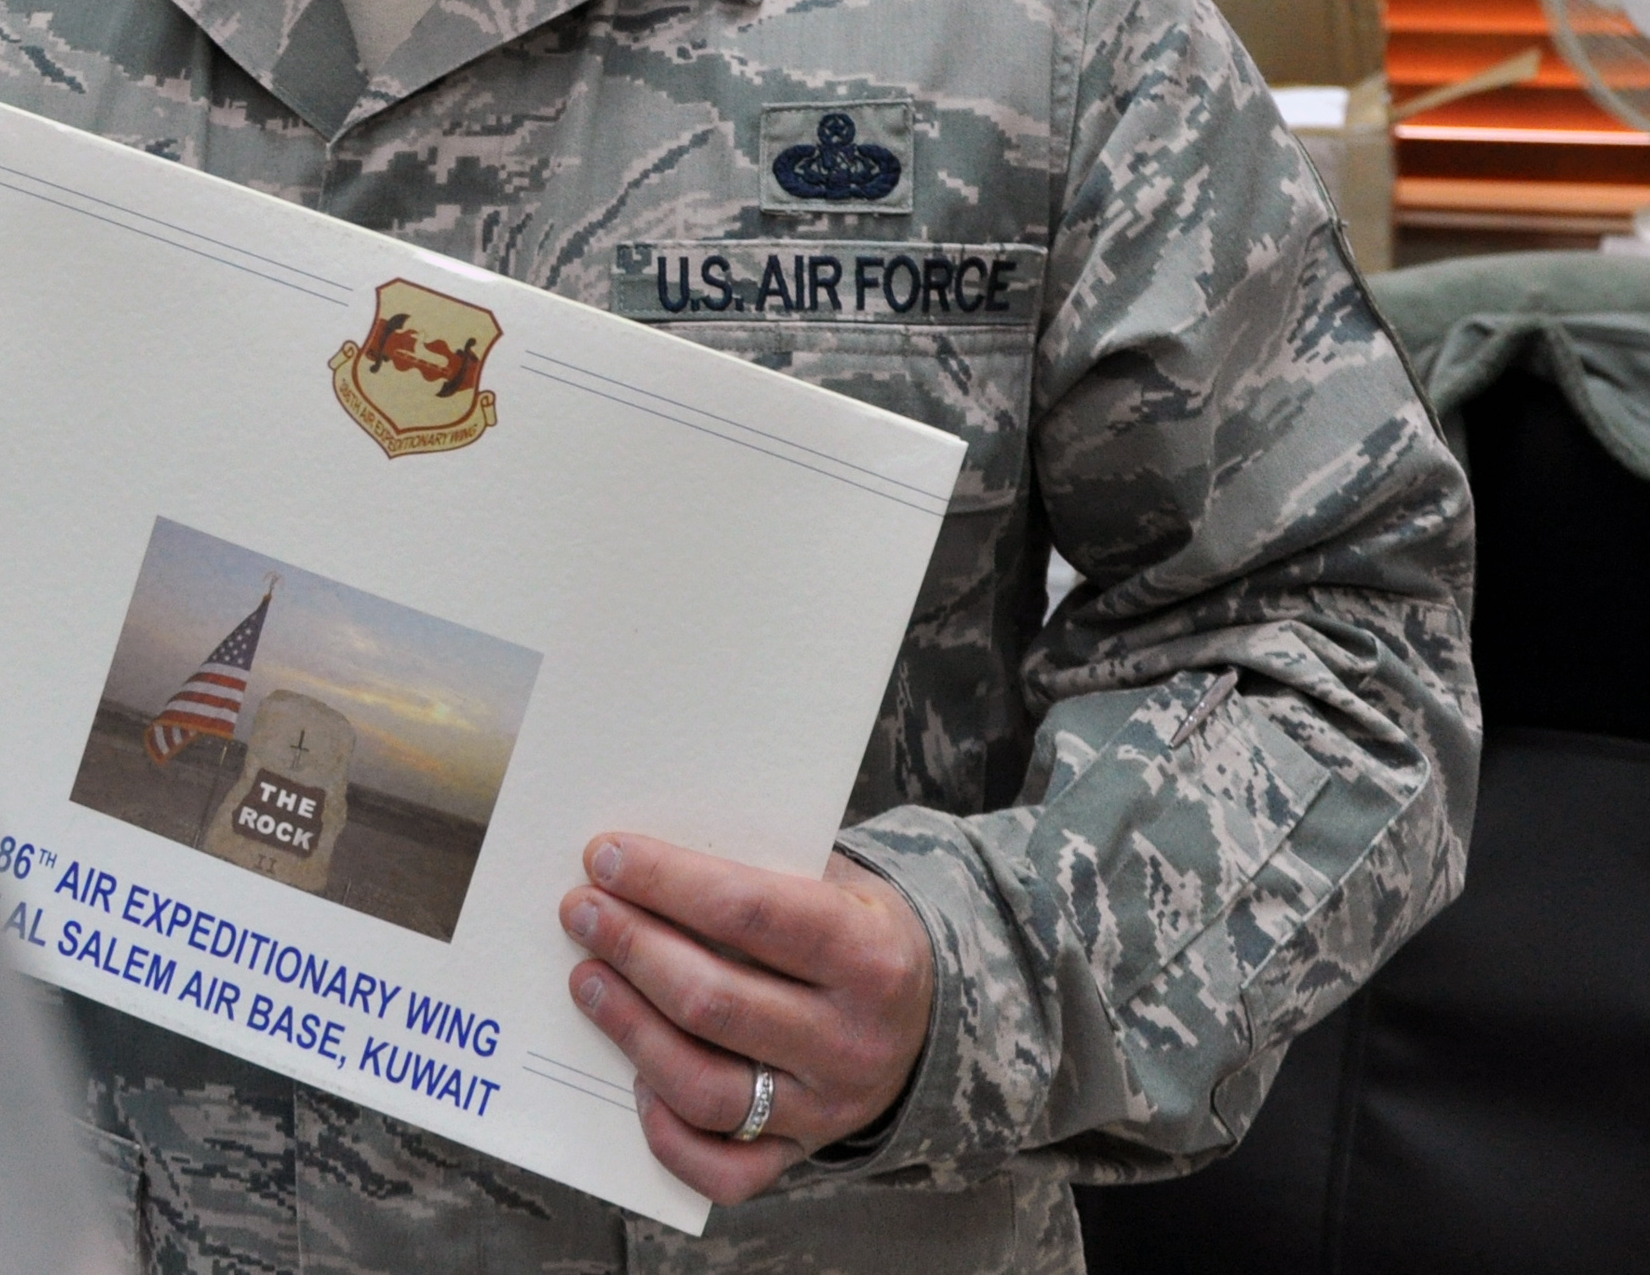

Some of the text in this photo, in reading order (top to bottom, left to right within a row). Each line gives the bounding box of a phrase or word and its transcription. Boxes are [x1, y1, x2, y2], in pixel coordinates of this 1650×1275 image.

[657, 254, 1018, 314] U.S. AIR FORCE
[238, 805, 315, 851] ROCK
[260, 781, 317, 819] THE
[54, 861, 118, 912] AIR
[122, 884, 402, 1020] EXPEDITIONARY
[407, 991, 501, 1058] WING
[3, 900, 501, 1117] AL SALEM AIR BASE, KUWAIT
